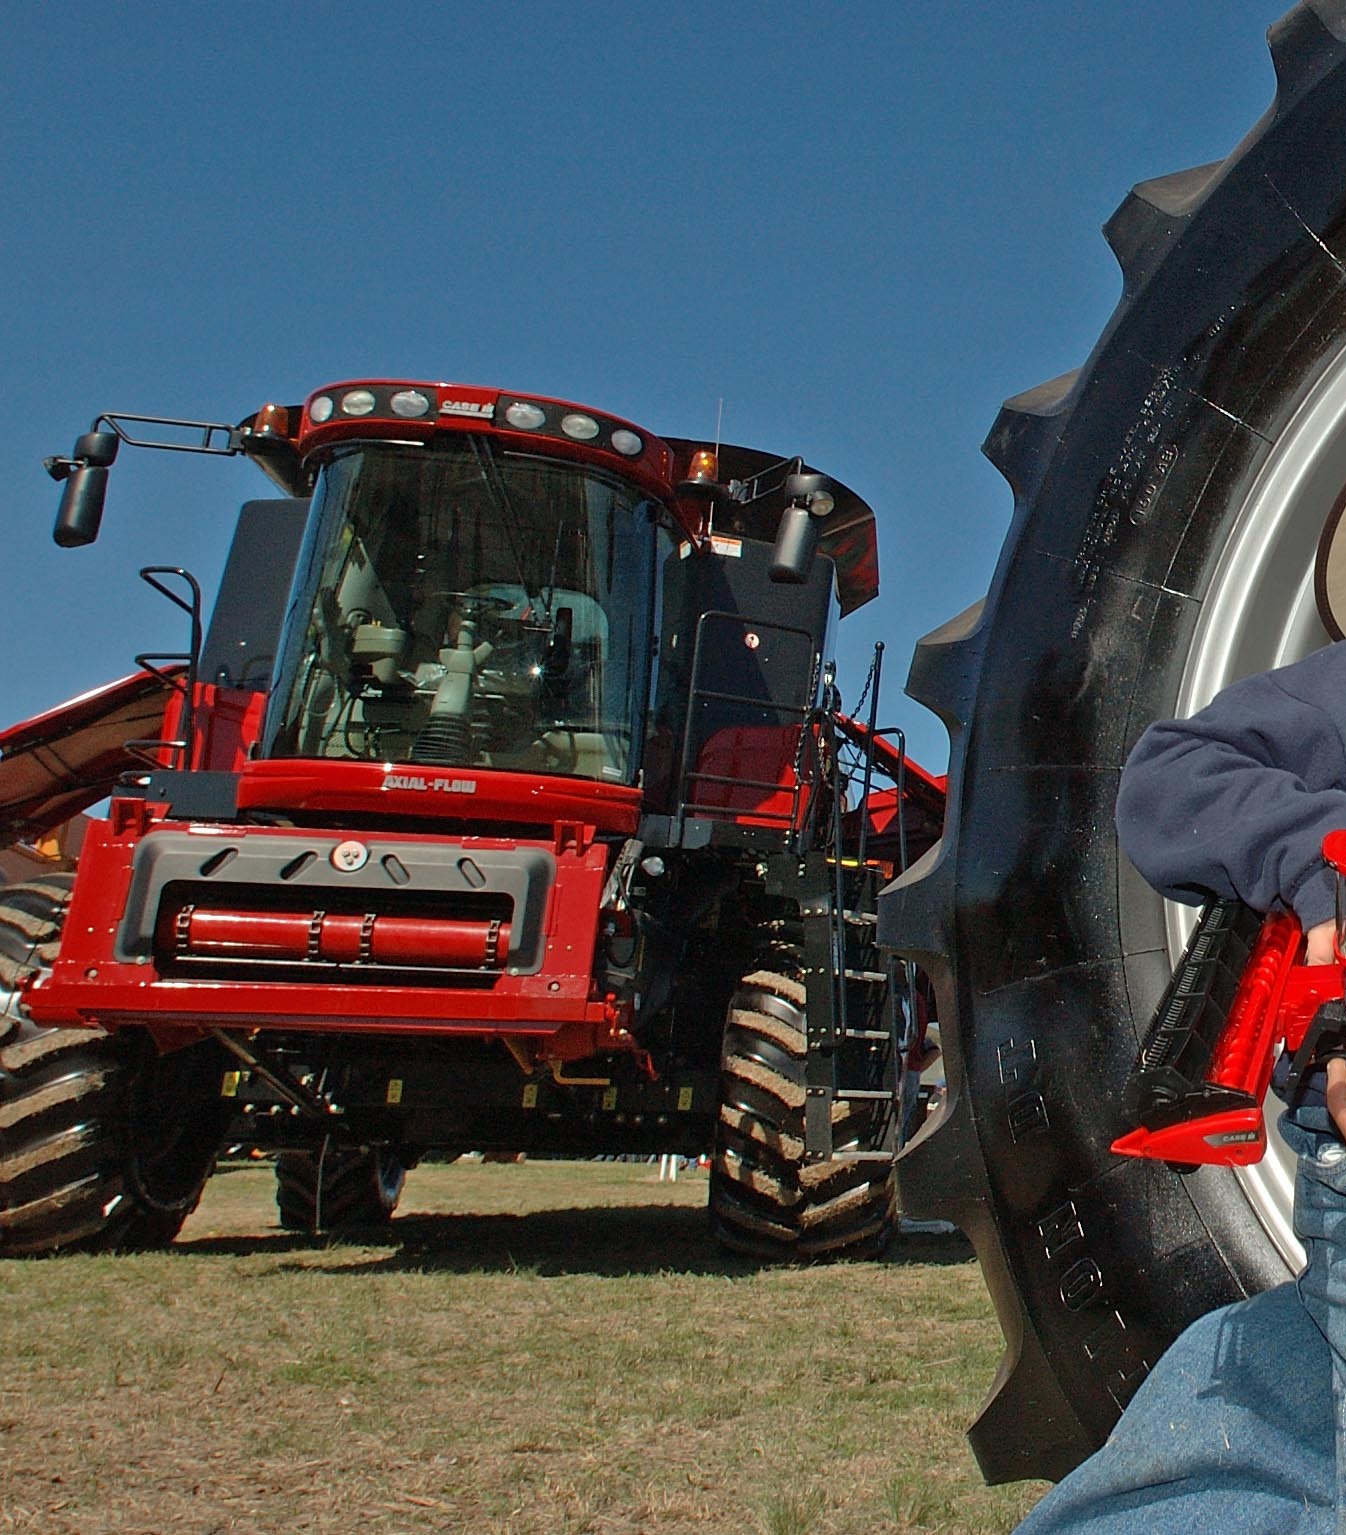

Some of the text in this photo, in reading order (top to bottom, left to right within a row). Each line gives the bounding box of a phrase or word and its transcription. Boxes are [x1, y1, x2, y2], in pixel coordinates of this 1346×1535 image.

[441, 400, 480, 412] CASE
[382, 774, 477, 794] AXIAL-FLOW
[1222, 1133, 1247, 1142] CASE
